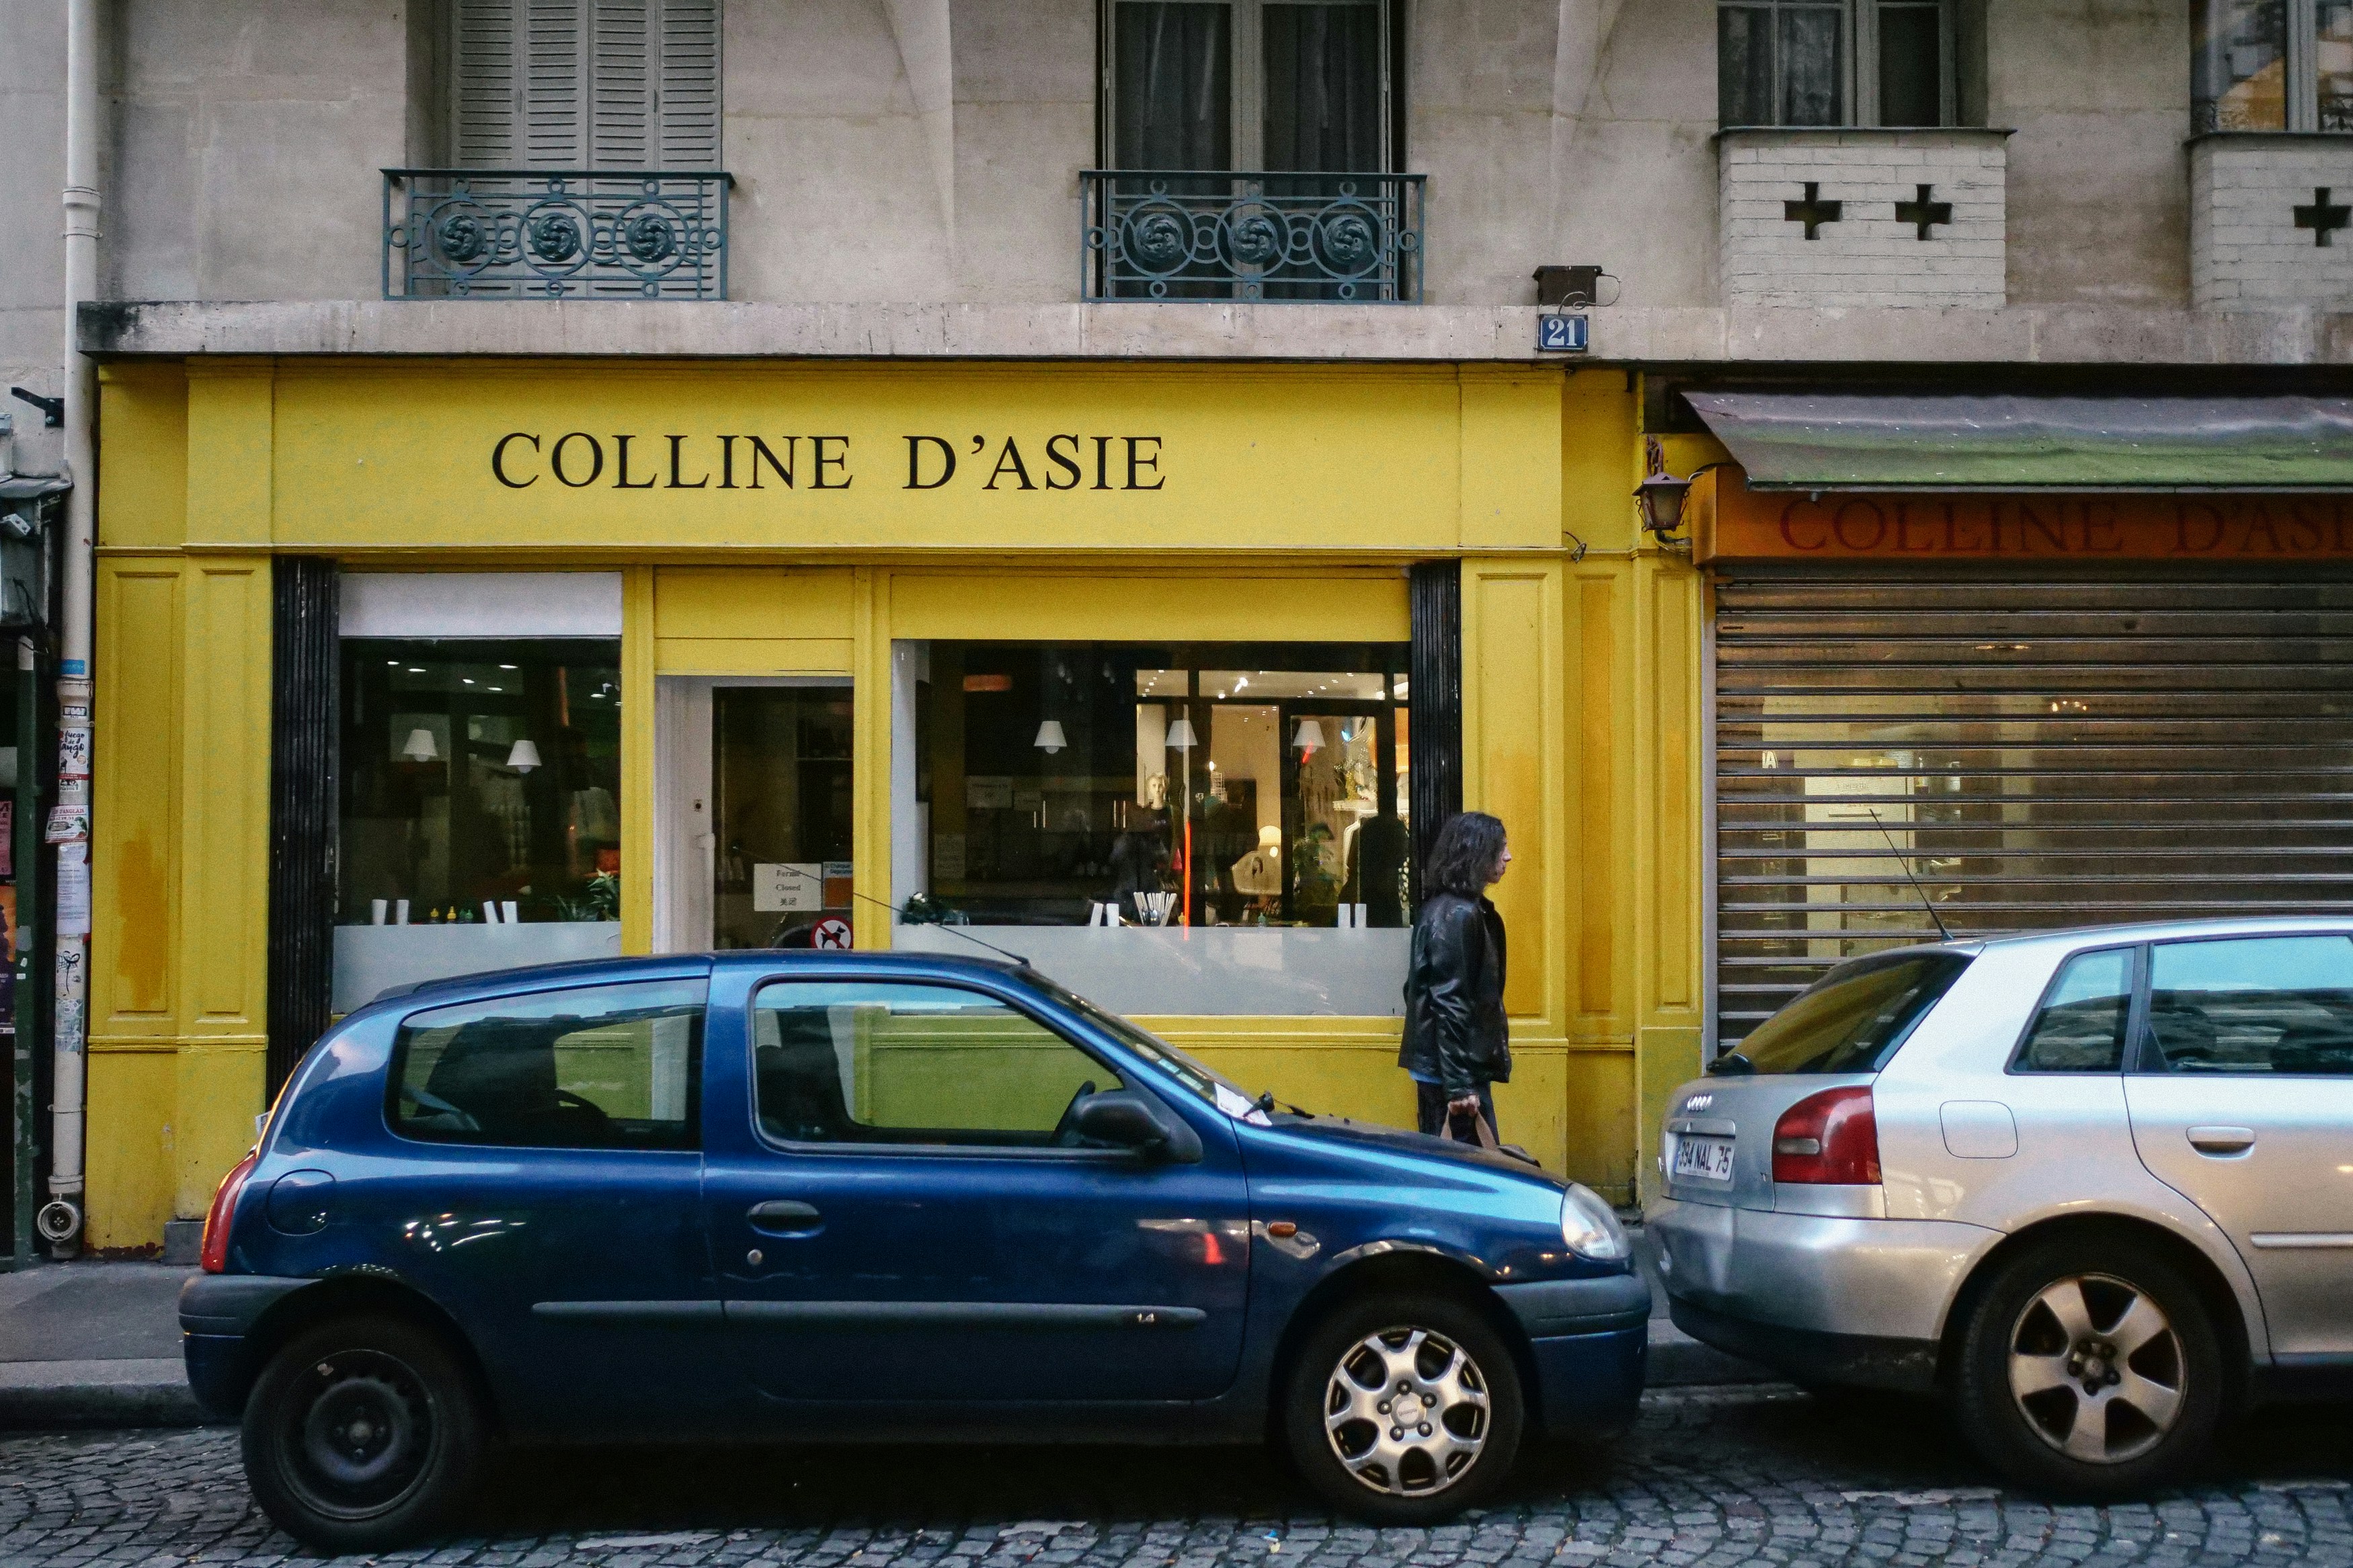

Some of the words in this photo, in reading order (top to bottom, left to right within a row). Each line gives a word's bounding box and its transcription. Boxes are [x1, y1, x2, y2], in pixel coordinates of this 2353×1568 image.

[1547, 319, 1577, 346] 21
[491, 431, 854, 489] COLLINE
[902, 434, 1166, 491] D'ASIE
[1780, 496, 2124, 553] COLLINE
[1694, 1143, 1712, 1171] NAL
[1716, 1145, 1732, 1174] 75
